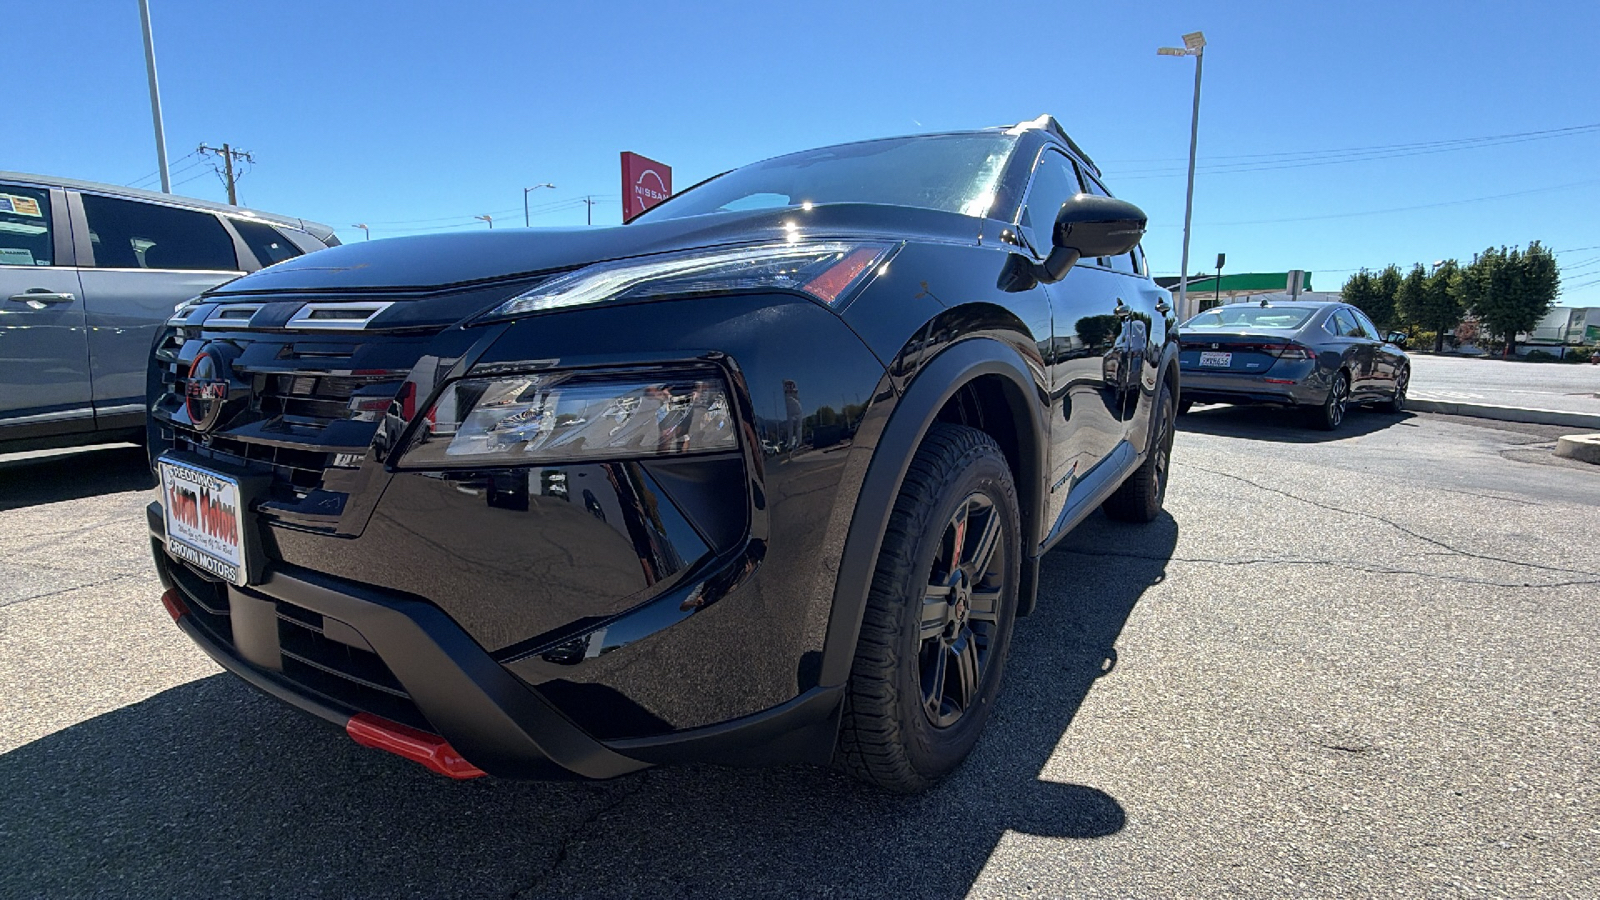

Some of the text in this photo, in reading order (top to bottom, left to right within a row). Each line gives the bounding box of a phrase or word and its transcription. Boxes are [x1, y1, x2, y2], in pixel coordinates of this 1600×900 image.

[635, 185, 669, 200] NISSAN
[173, 466, 214, 488] REDDING
[170, 539, 236, 581] CROWN MOTORS
